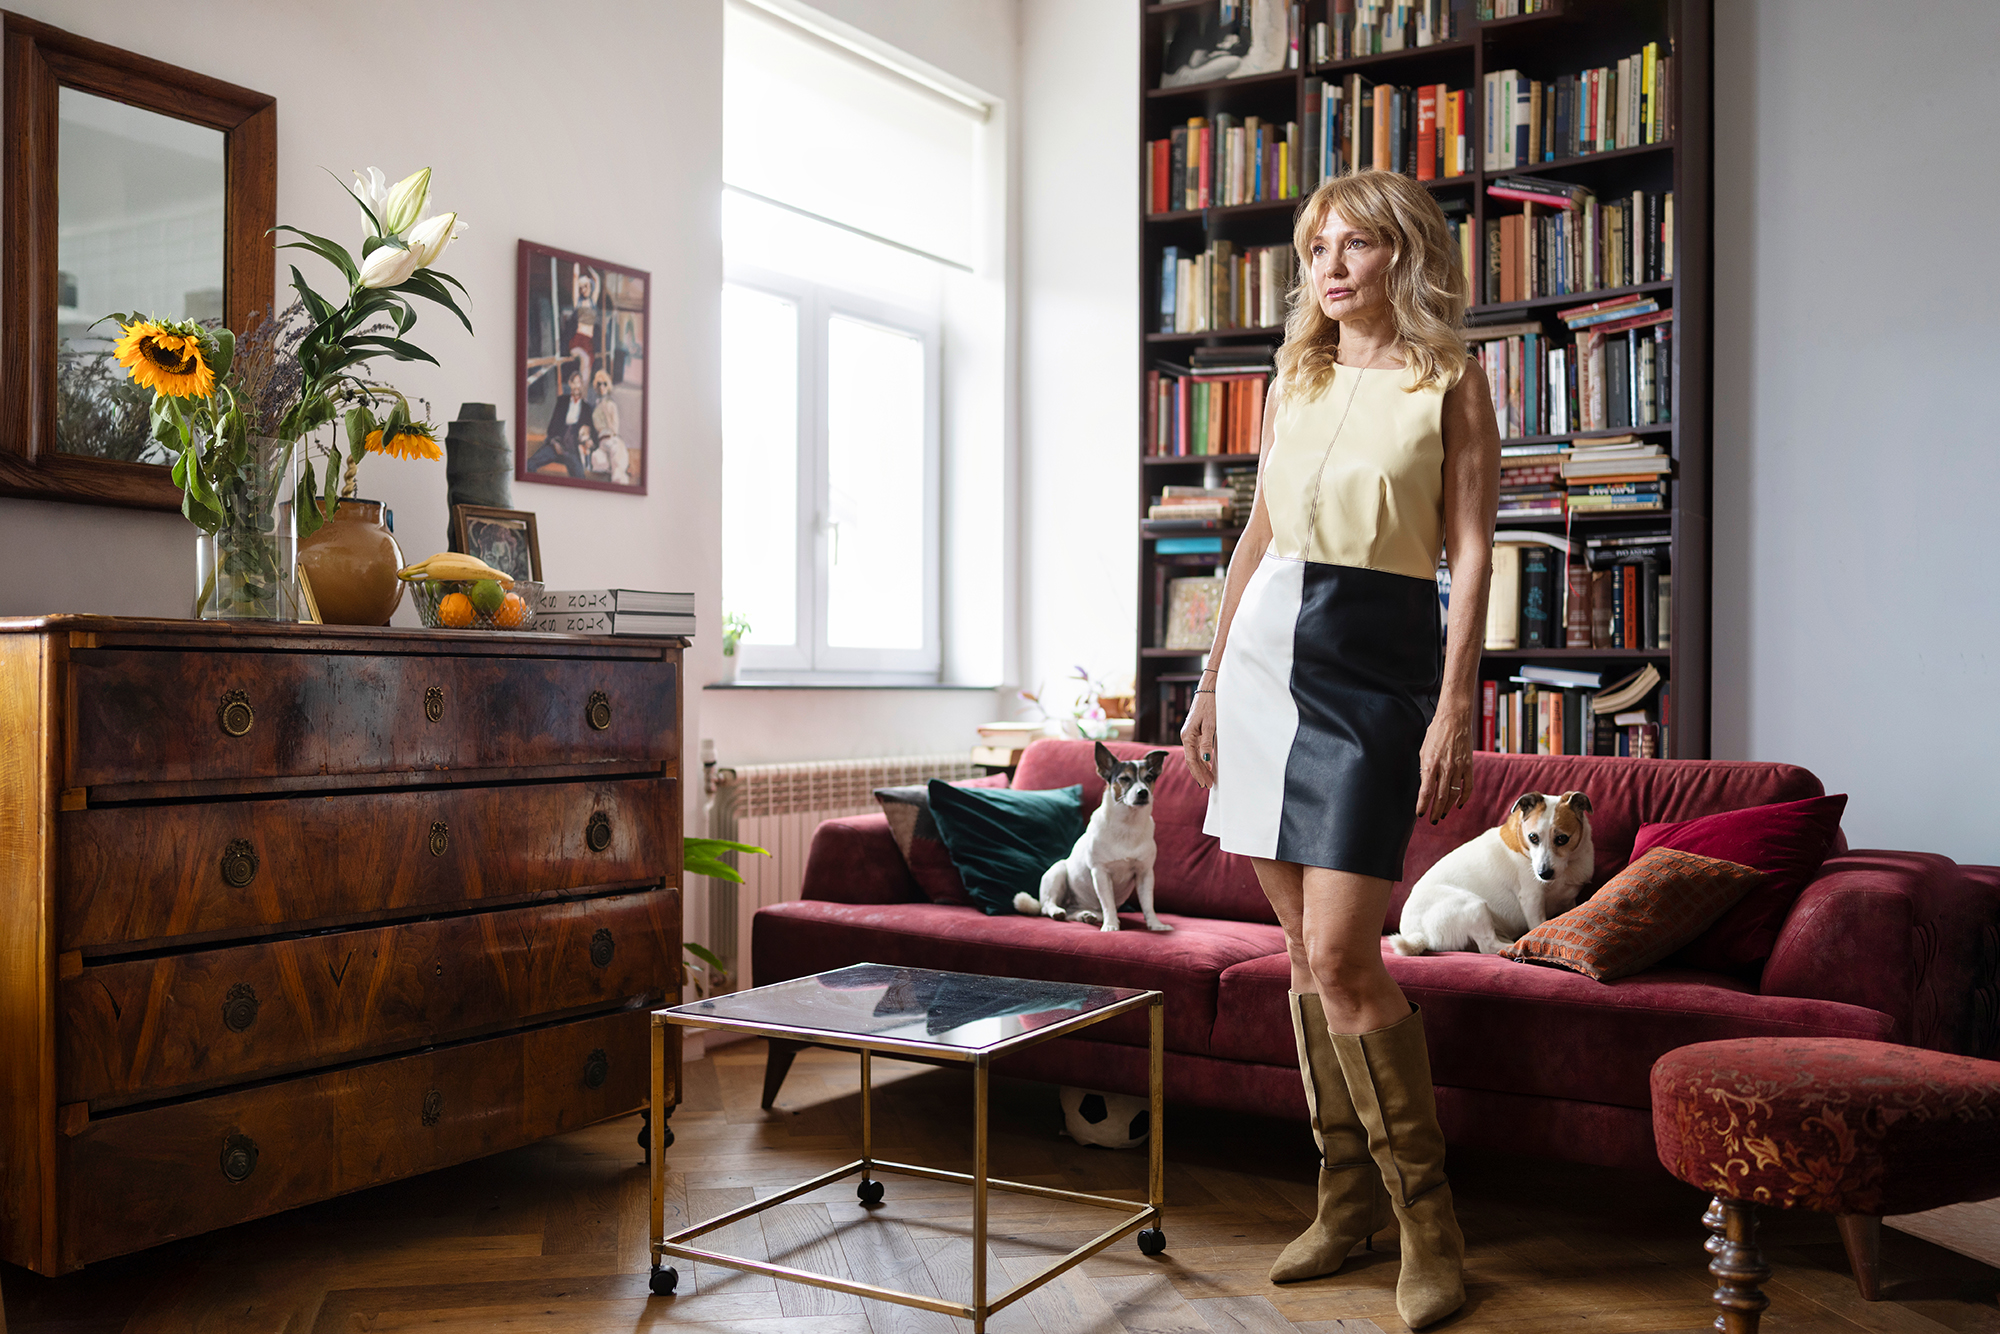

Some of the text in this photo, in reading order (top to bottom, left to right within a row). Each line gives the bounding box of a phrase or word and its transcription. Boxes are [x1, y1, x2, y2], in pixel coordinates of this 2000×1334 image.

[539, 594, 608, 608] AS NOLA
[530, 617, 605, 632] KAS NOLA
